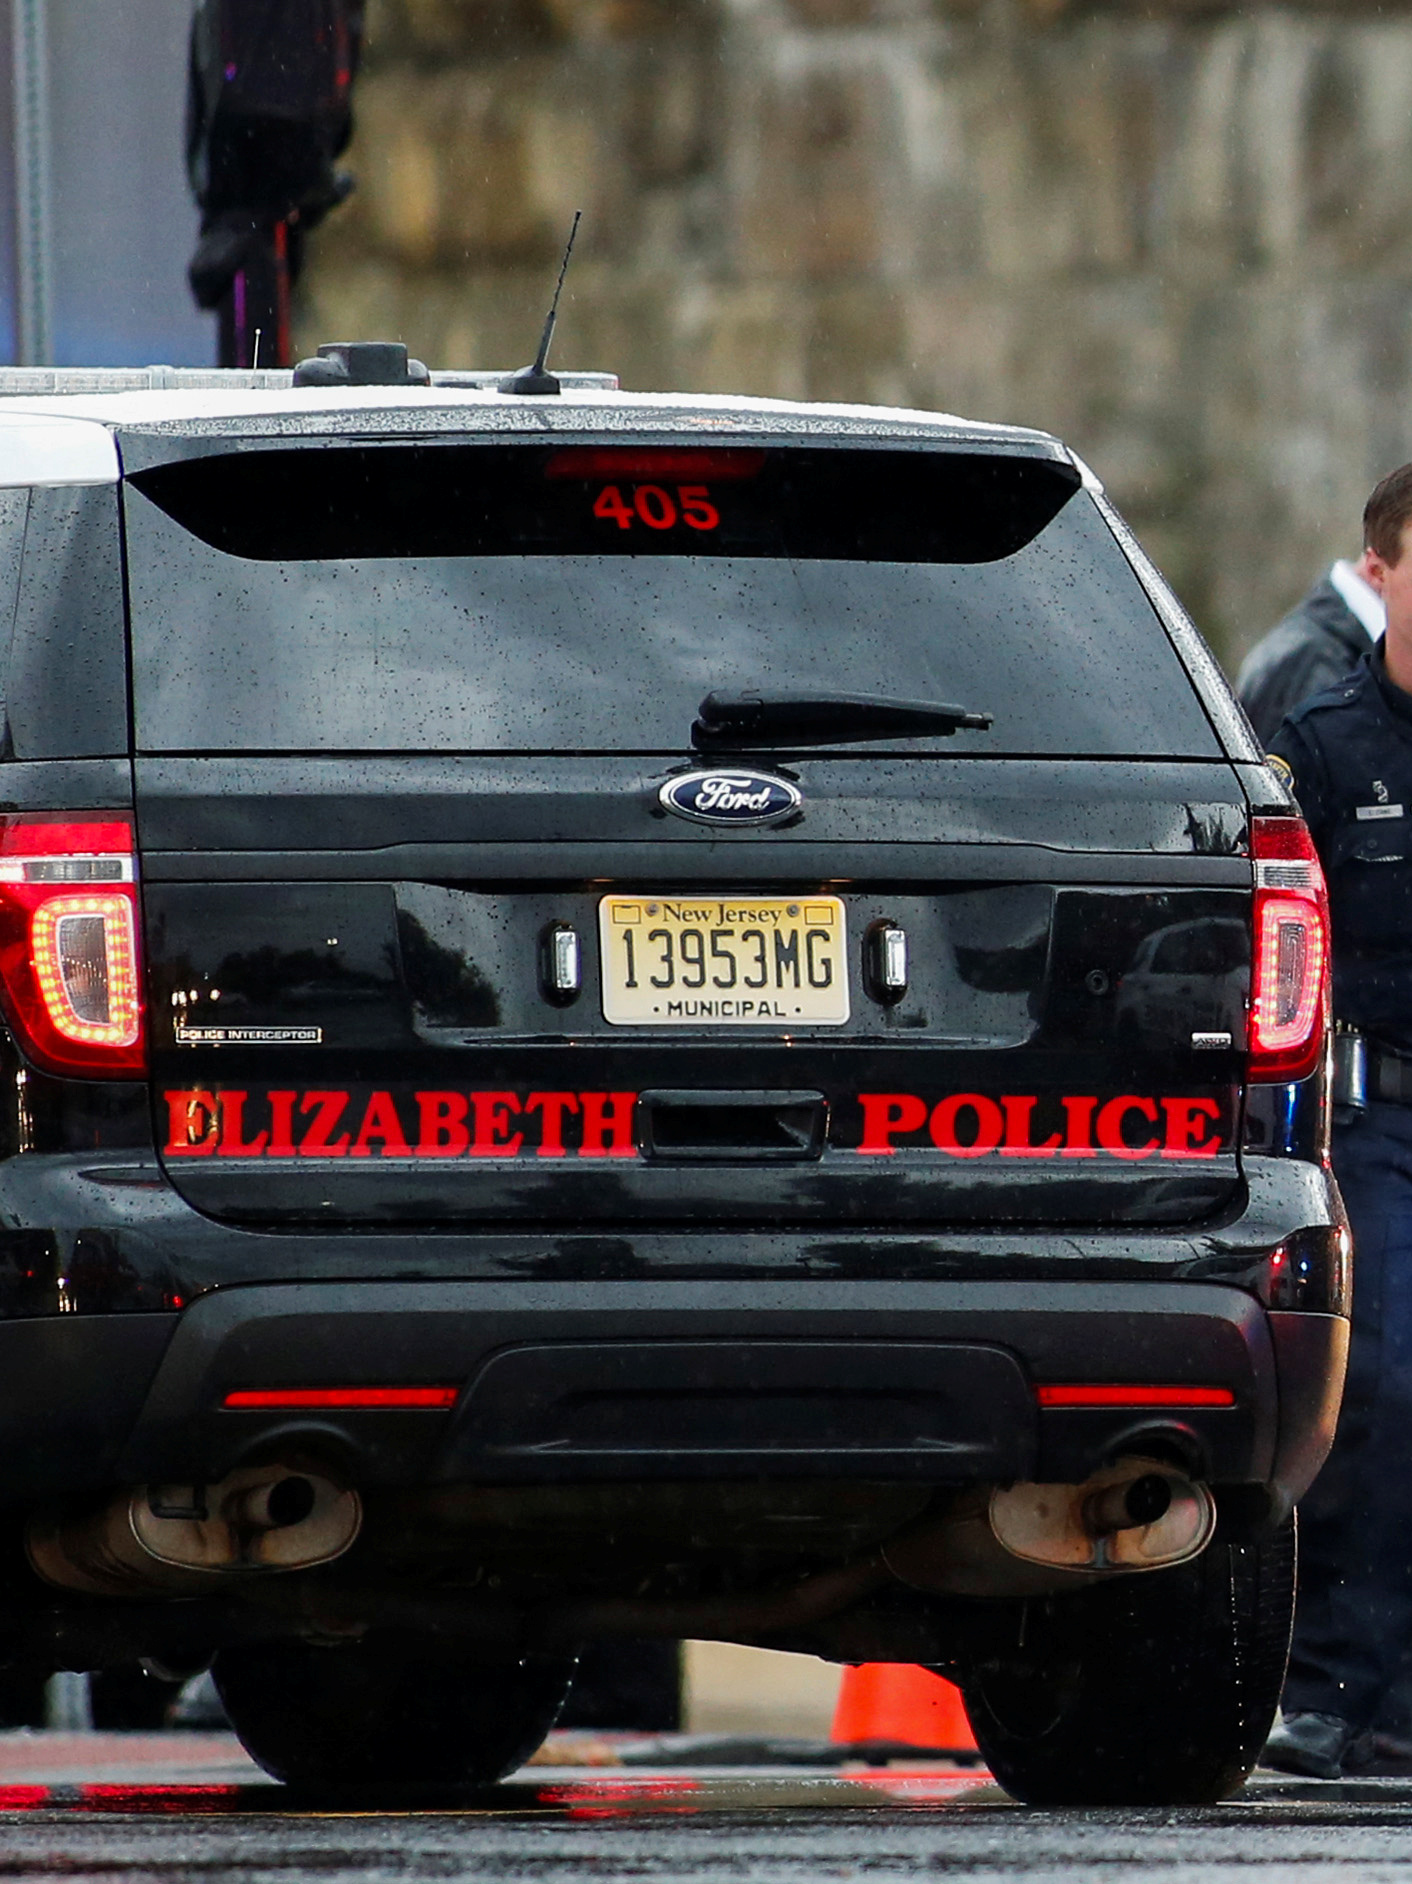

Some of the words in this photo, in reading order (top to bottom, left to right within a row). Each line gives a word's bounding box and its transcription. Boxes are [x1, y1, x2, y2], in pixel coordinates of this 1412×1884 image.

[593, 485, 720, 530] 405
[695, 777, 771, 810] Ford
[662, 903, 712, 922] New
[716, 903, 782, 926] Jersey
[622, 928, 832, 989] 13953MG
[667, 1001, 787, 1017] MUNICIPAL
[179, 1030, 225, 1040] POLICE
[228, 1030, 316, 1040] INTERCEPTOR
[163, 1090, 638, 1157] ELIZABETH
[856, 1093, 1222, 1160] POLICE
